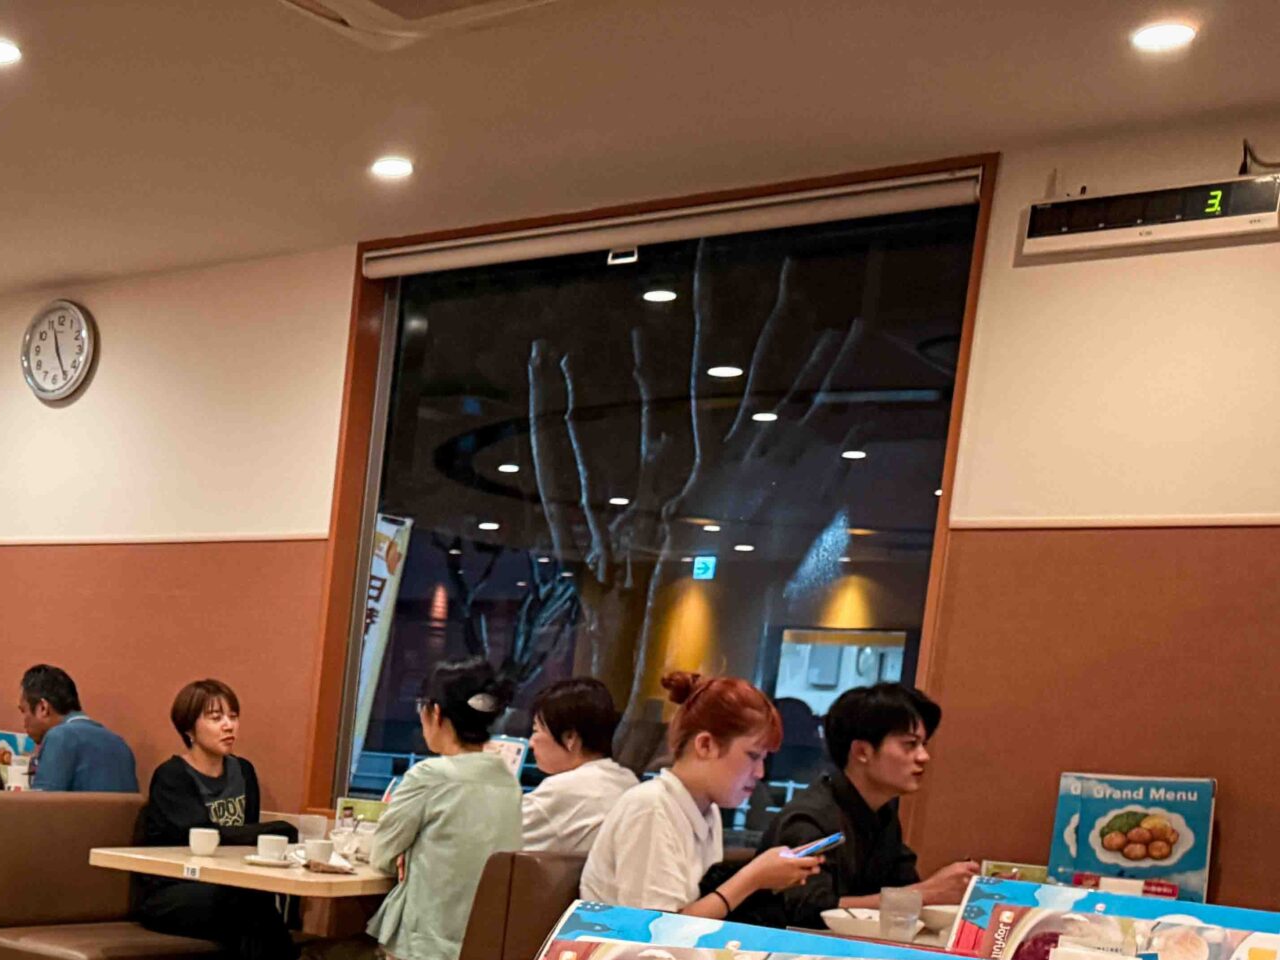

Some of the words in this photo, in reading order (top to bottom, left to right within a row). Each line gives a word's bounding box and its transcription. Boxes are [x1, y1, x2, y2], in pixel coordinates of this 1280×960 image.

[58, 315, 66, 326] 12
[39, 330, 47, 341] 10
[74, 330, 81, 341] 2
[35, 345, 41, 356] 9
[1093, 787, 1144, 800] Grand
[1150, 787, 1198, 801] Menu
[991, 923, 1011, 958] Joyfull
